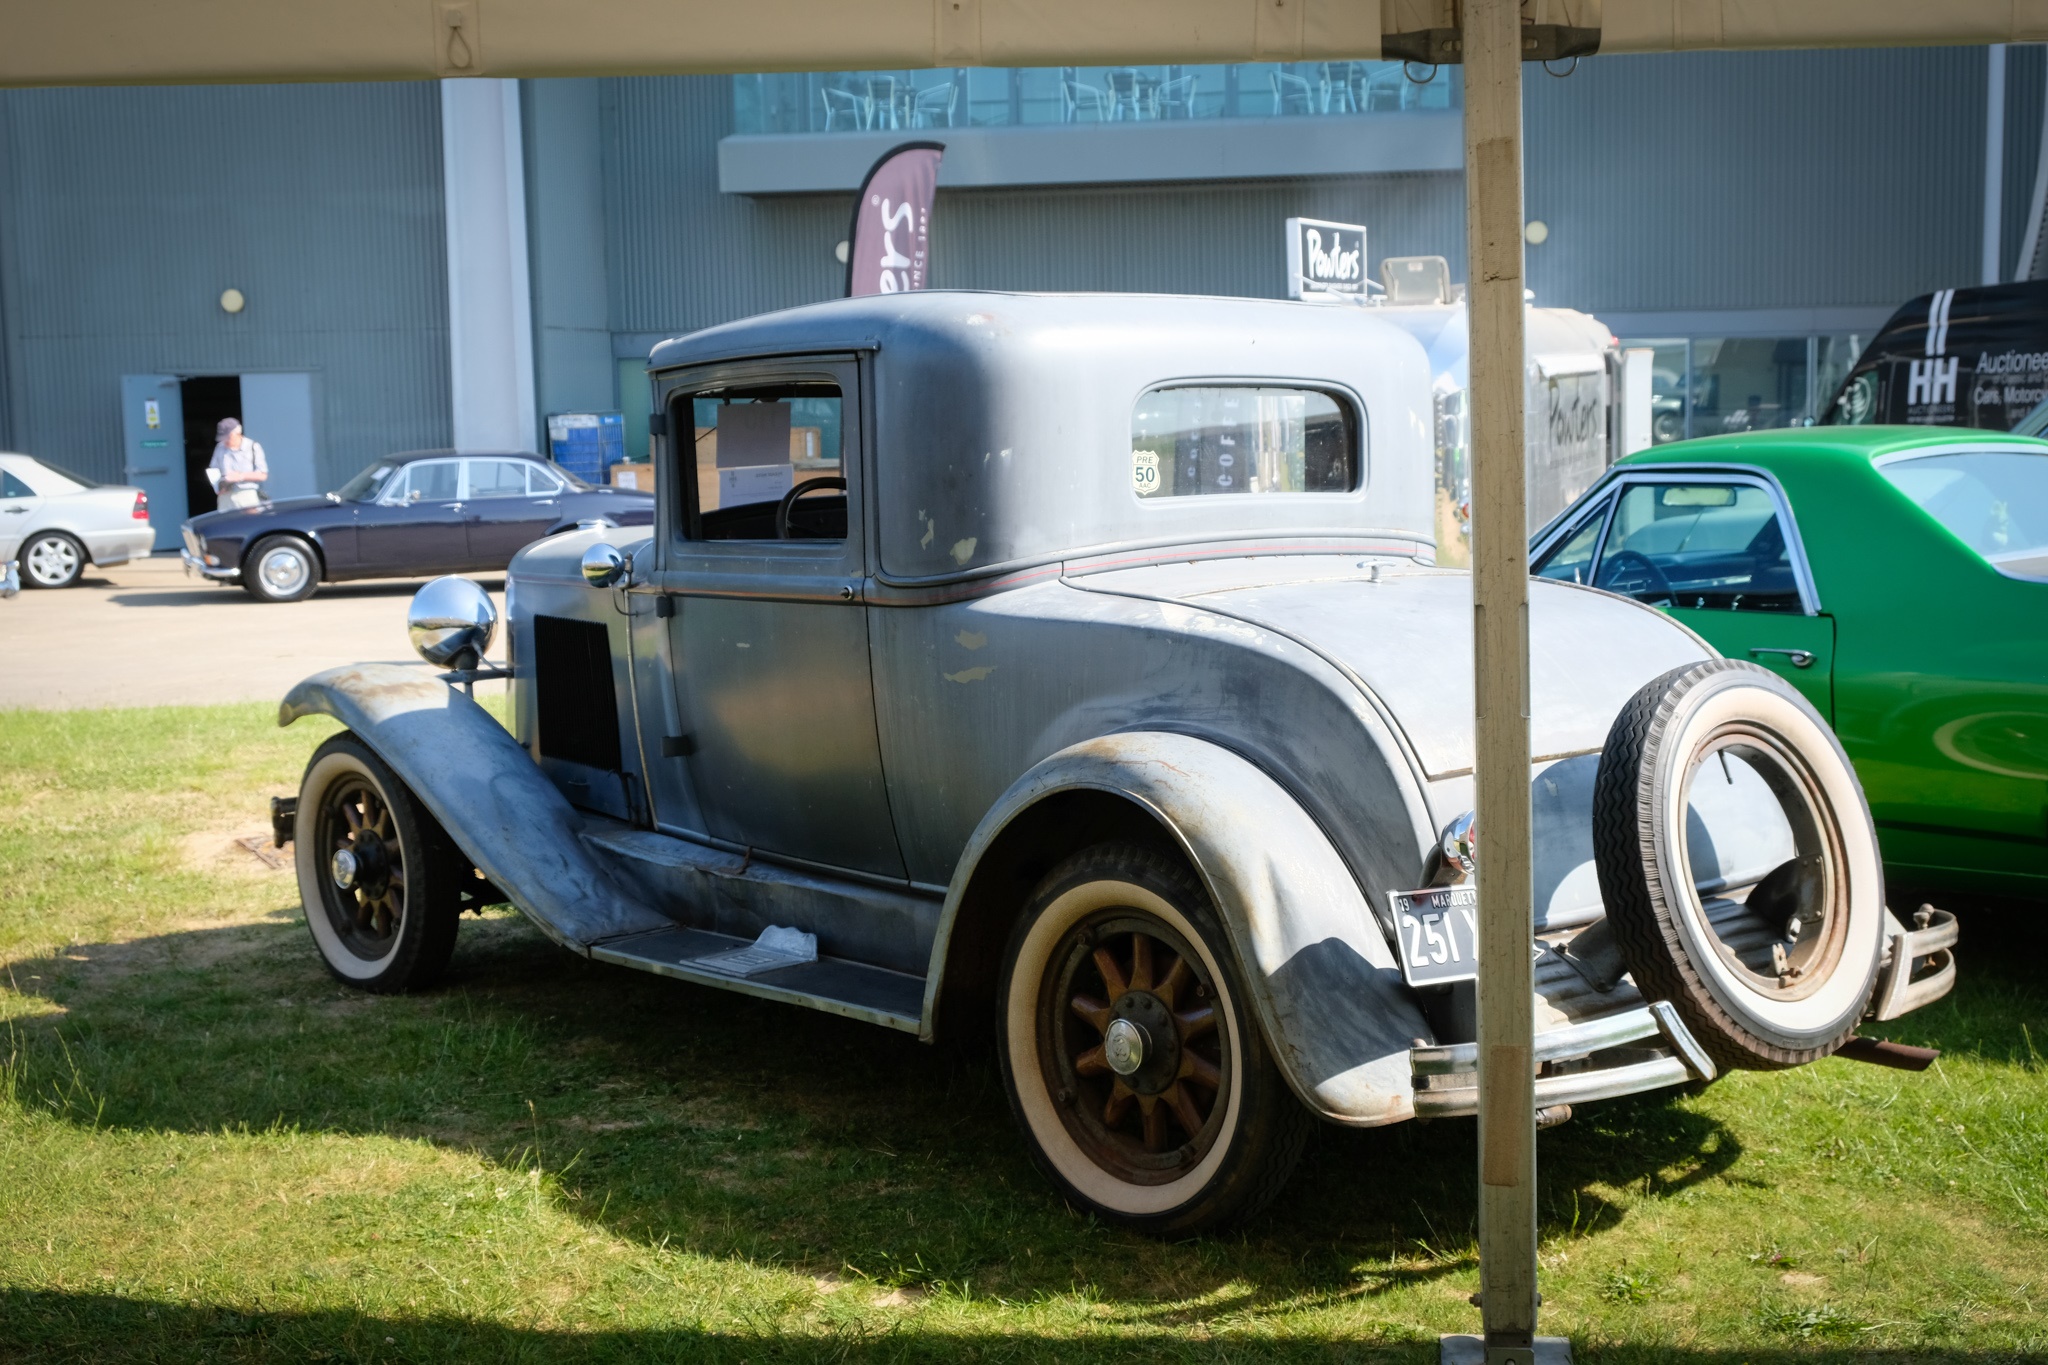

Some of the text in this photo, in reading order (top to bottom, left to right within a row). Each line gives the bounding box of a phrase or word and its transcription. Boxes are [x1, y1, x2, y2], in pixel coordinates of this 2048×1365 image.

[1136, 455, 1154, 464] PRE
[1135, 466, 1155, 483] 50
[1398, 897, 1410, 912] 19
